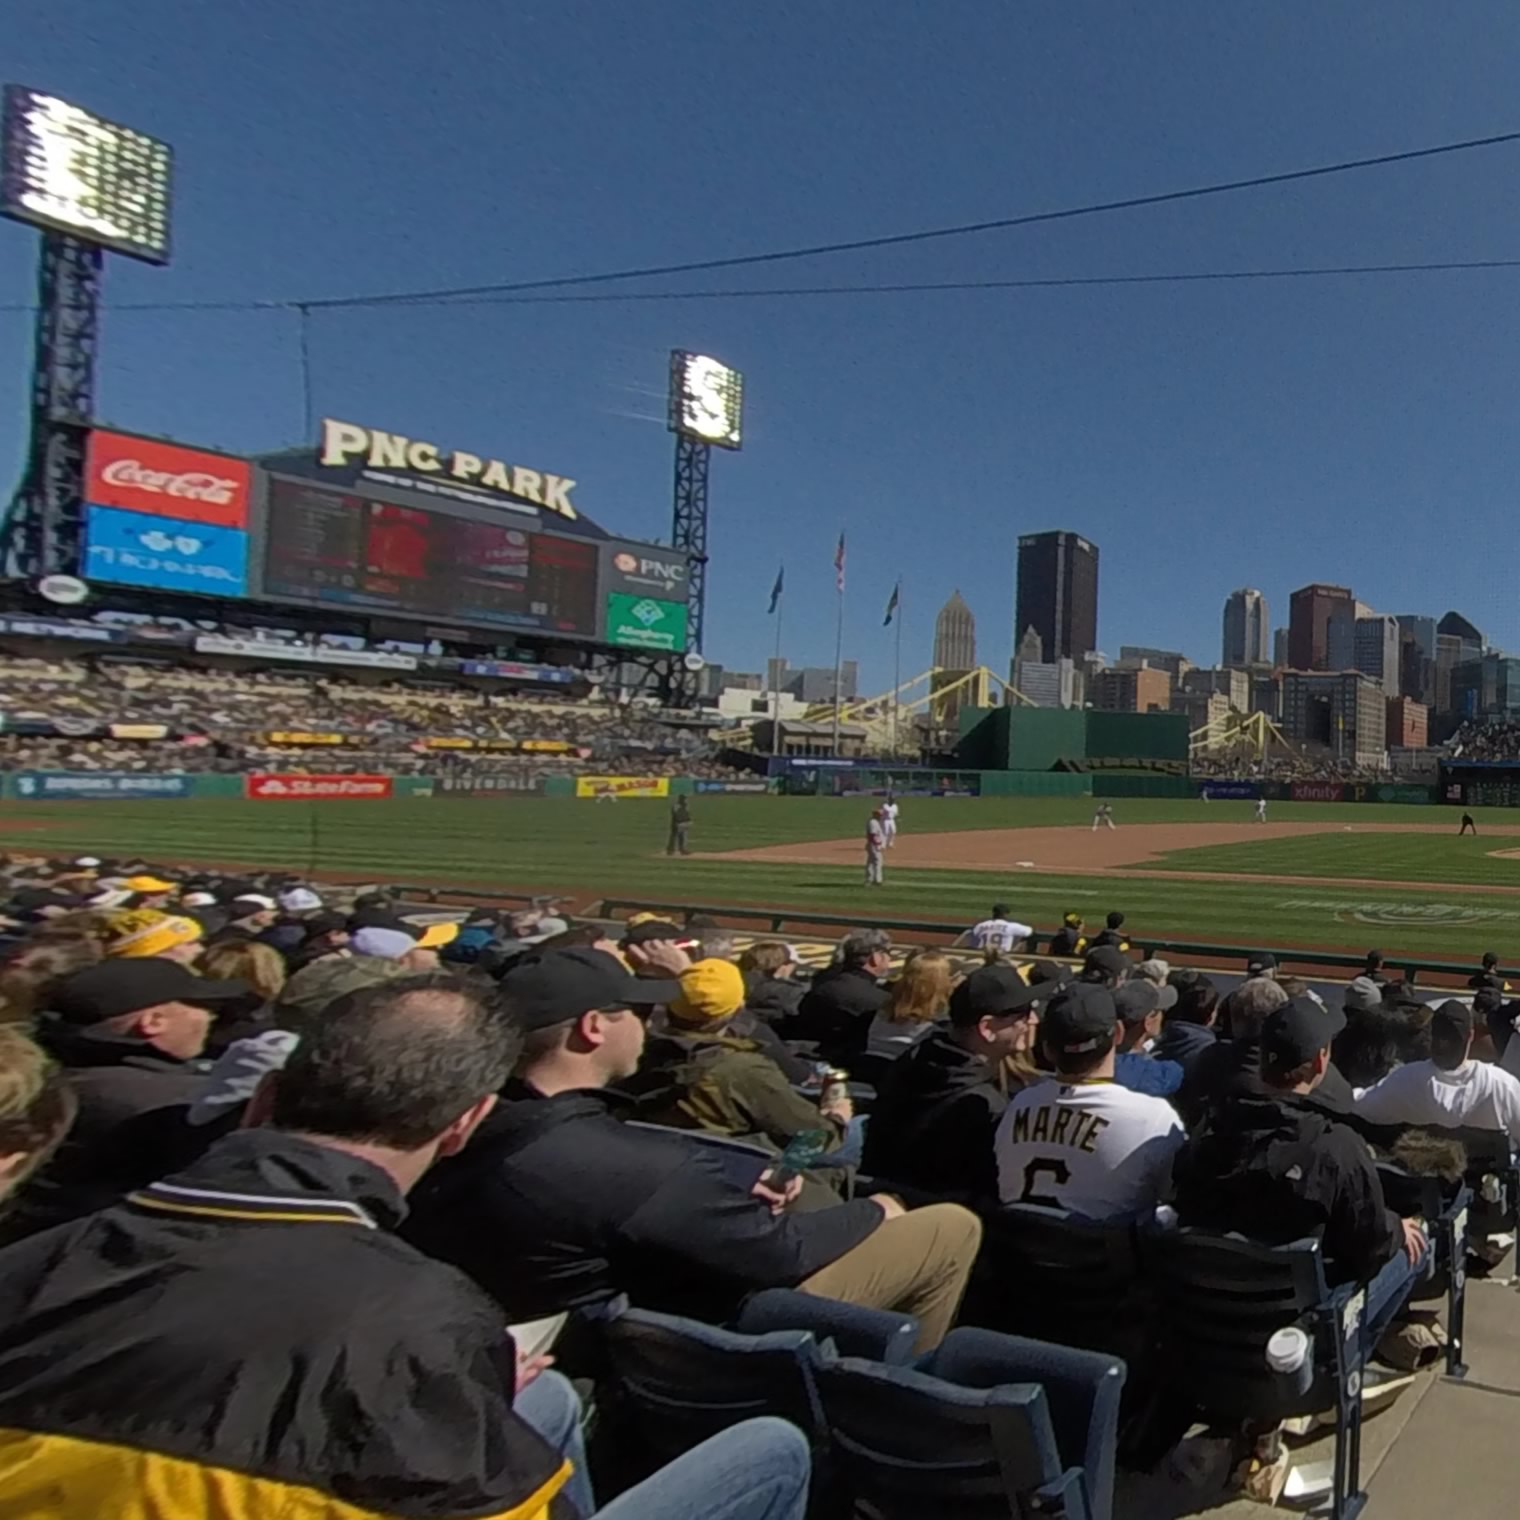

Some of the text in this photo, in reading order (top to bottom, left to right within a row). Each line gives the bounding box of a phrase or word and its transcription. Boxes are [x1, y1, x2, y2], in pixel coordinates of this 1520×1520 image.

[102, 459, 240, 505] Coca-Cola
[320, 417, 443, 471] PNC
[451, 450, 578, 520] PARK
[640, 558, 684, 580] PNC
[1294, 785, 1341, 801] xfinity
[1012, 1105, 1110, 1153] MARTE
